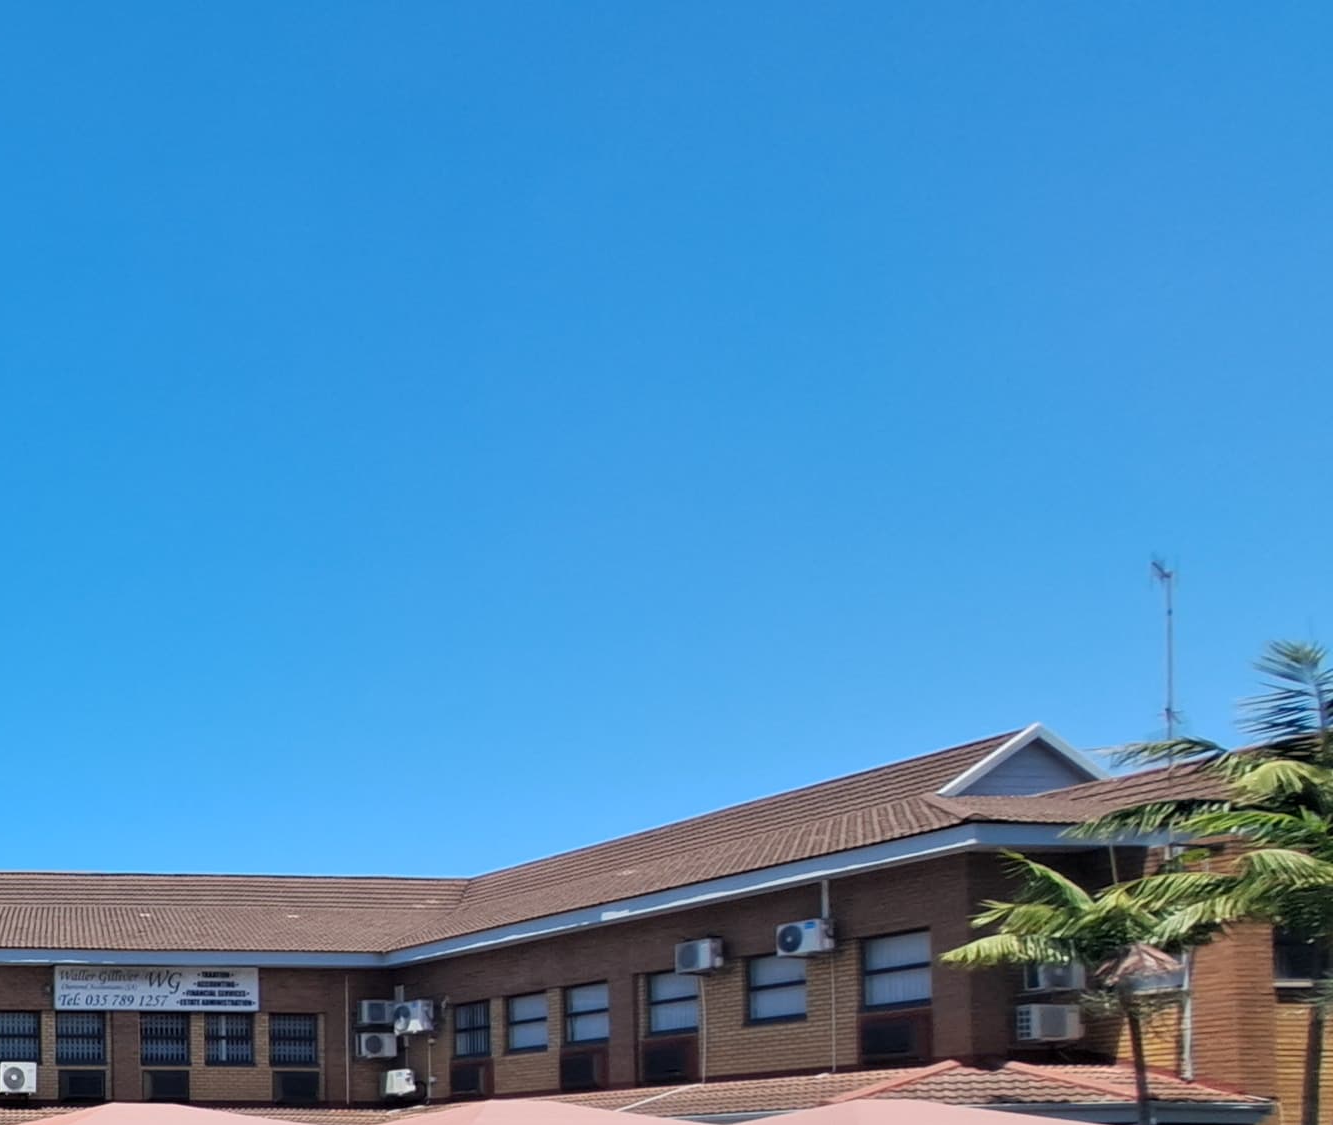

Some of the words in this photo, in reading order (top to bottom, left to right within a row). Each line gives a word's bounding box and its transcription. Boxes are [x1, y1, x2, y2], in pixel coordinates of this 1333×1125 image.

[147, 969, 182, 994] WG
[60, 992, 79, 1007] Tel:
[85, 994, 108, 1007] 035
[112, 994, 134, 1007] 789
[139, 994, 169, 1007] 1257
